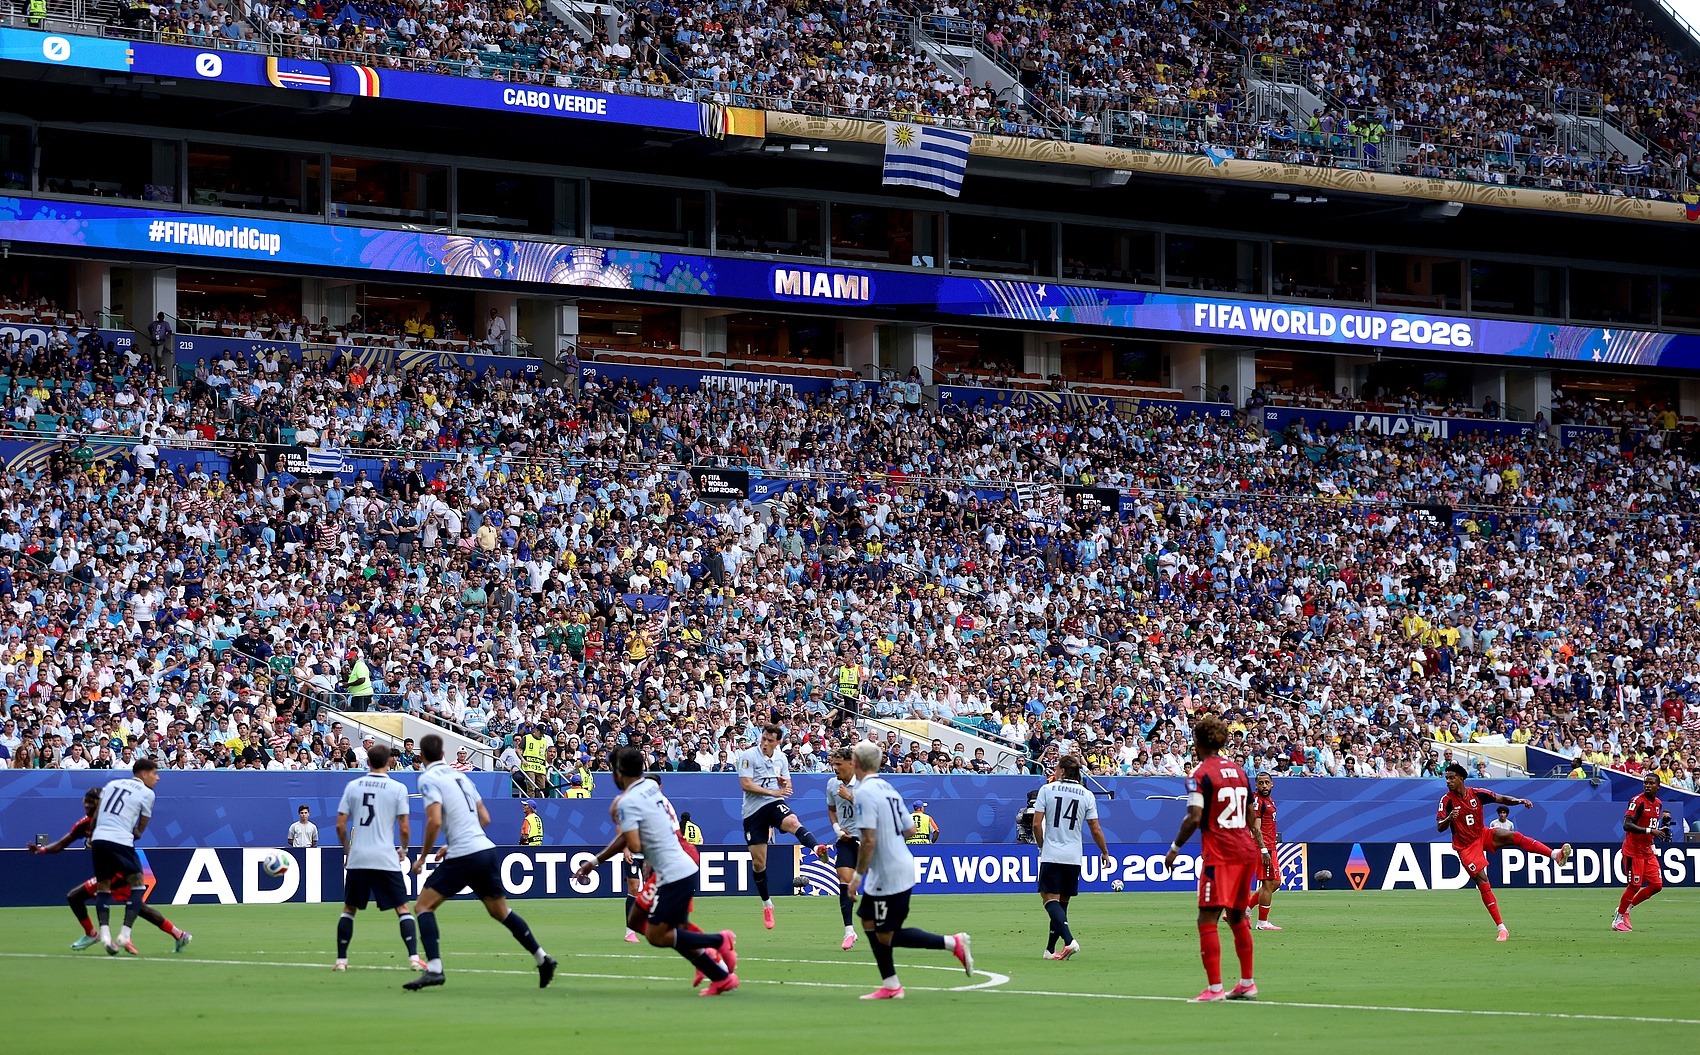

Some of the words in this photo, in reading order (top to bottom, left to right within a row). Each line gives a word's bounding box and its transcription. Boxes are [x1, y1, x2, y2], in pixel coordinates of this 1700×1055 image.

[43, 36, 71, 61] 0
[195, 53, 222, 77] 0
[503, 88, 550, 109] CABO
[553, 93, 607, 115] VERDE
[148, 220, 281, 256] #FIFAWorldCup
[775, 269, 868, 301] MIAMI
[1193, 303, 1247, 330] FIFA
[1249, 307, 1337, 337] WORLD
[1340, 314, 1388, 340] CUP
[1390, 318, 1472, 347] 2026
[117, 337, 131, 346] 218
[179, 340, 193, 350] 219
[1266, 411, 1278, 420] 222
[1354, 414, 1448, 439] MIAMI
[1122, 502, 1134, 511] 121
[103, 786, 132, 816] 16
[359, 792, 376, 827] 5
[1053, 795, 1080, 831] 14
[1216, 786, 1249, 830] 20
[1465, 813, 1475, 826] 6
[171, 847, 322, 906] ADI
[913, 856, 949, 884] FA
[952, 855, 1042, 884] WORL
[1078, 854, 1119, 883] UP
[873, 900, 888, 920] 13
